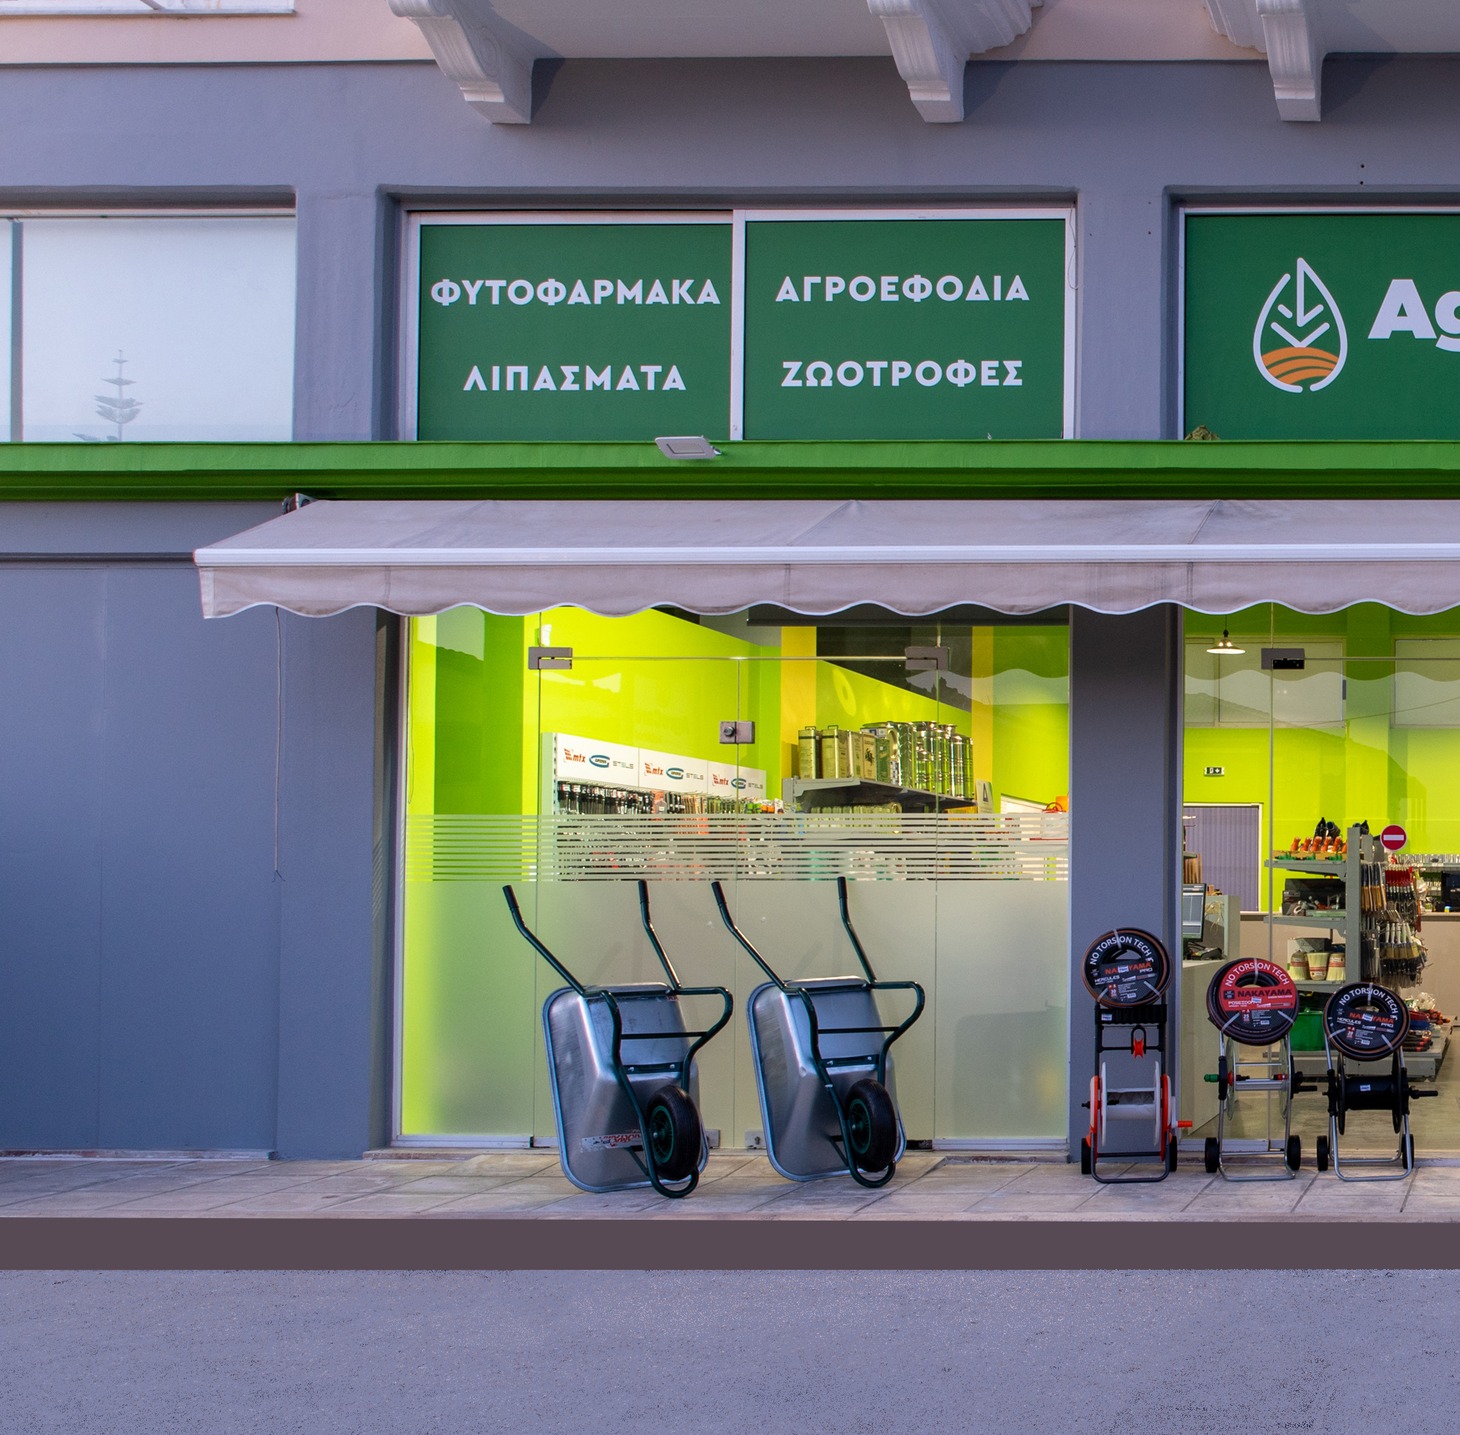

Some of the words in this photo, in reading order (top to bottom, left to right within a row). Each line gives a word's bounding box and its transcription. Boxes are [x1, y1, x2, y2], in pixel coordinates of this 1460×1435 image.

[431, 278, 721, 306] ΦΥΤΟΦΑΡΜΑΚΑ
[775, 274, 1030, 303] ΑΓΡΟΕΦΟΔΙΑ
[462, 364, 687, 392] ΛΙΠΑΣΜΑΤΑ
[780, 359, 1024, 388] ΖΩΟΤΡΟΦΕΣ
[1089, 952, 1100, 966] NO
[1133, 938, 1152, 957] TECH
[1104, 962, 1152, 975] NAYAMA
[1225, 973, 1236, 987] NO
[1272, 966, 1289, 985] TECH
[1237, 988, 1292, 997] NAKAYAMA
[1338, 994, 1350, 1006] NO
[1384, 995, 1398, 1014] TECH
